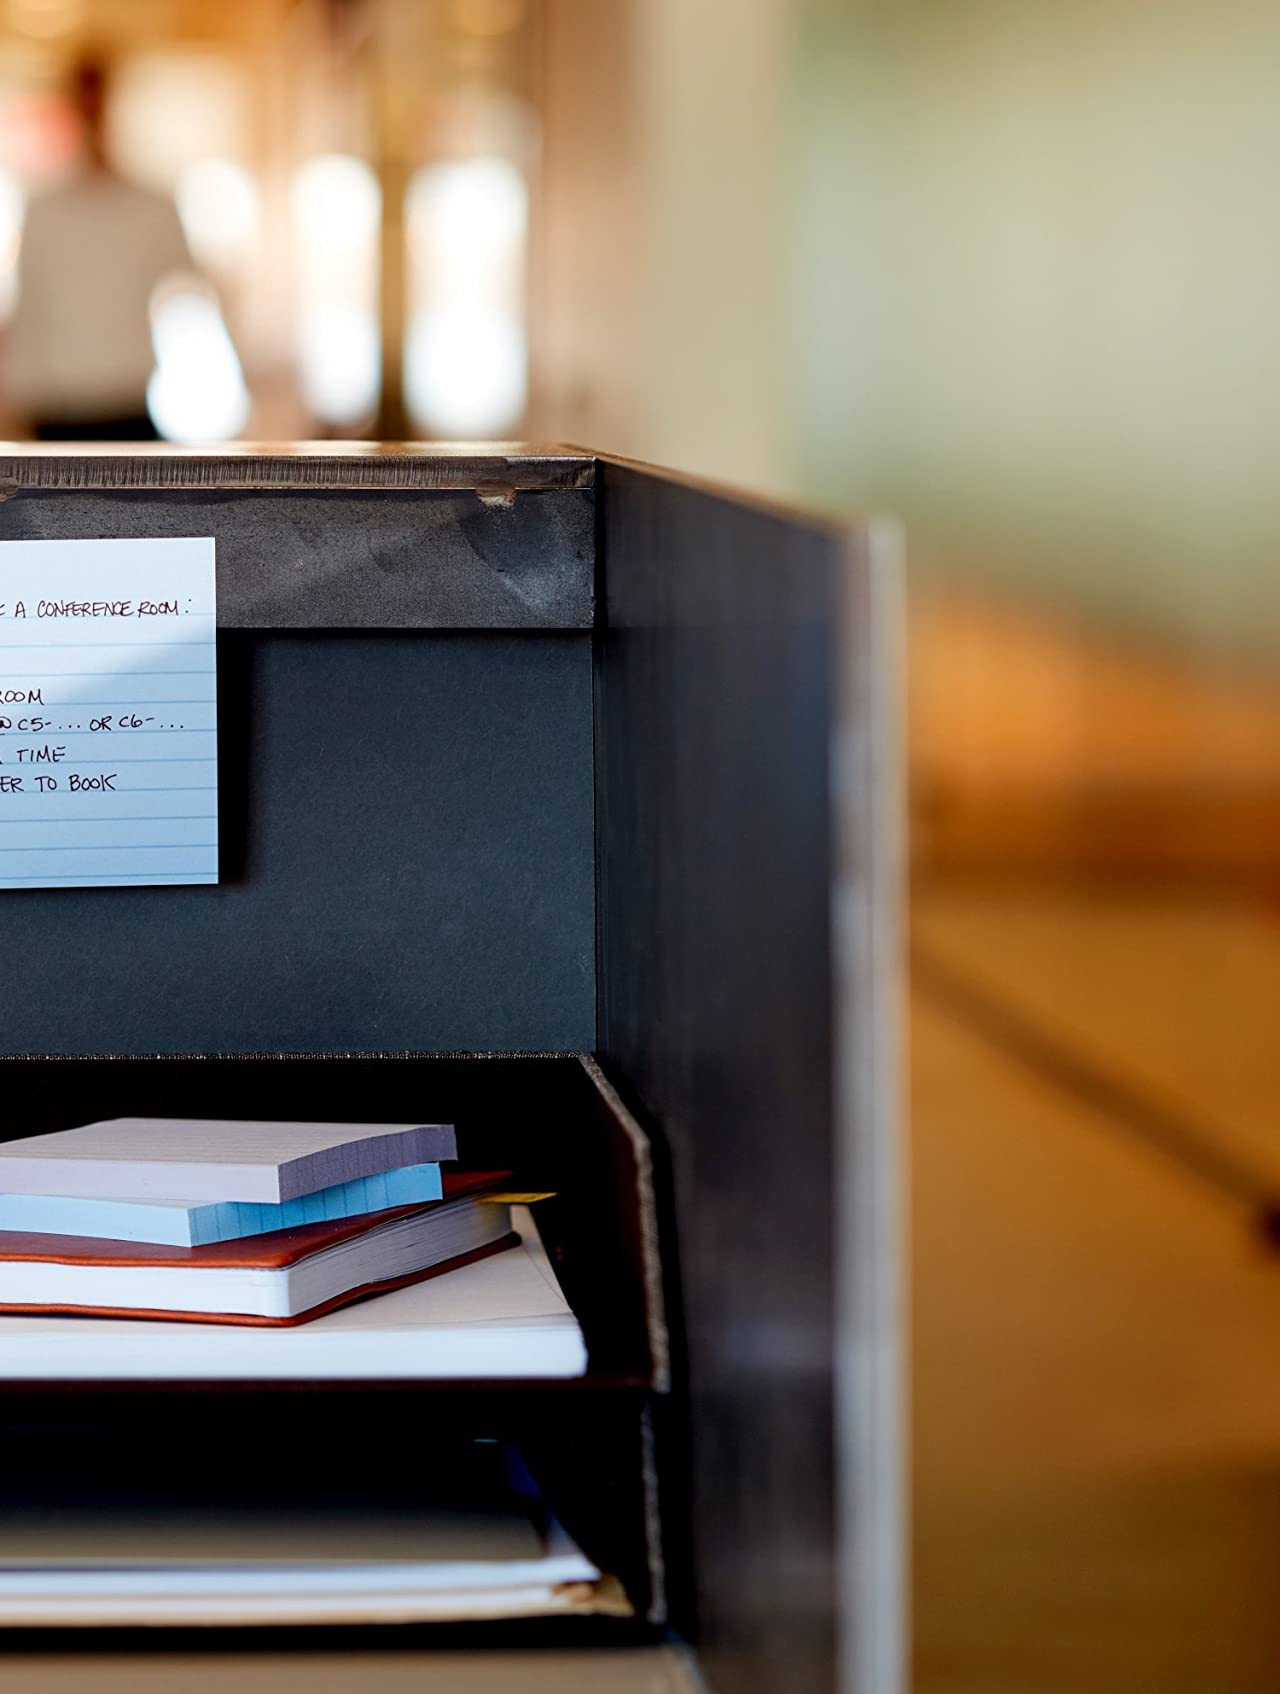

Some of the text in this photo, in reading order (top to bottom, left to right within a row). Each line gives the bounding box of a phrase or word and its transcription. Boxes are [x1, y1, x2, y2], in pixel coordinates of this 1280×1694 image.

[14, 600, 27, 619] A
[36, 599, 135, 619] CONFERENCE
[89, 715, 113, 732] OR
[16, 744, 67, 764] TIME
[33, 775, 58, 793] TO
[67, 773, 118, 793] BOOK
